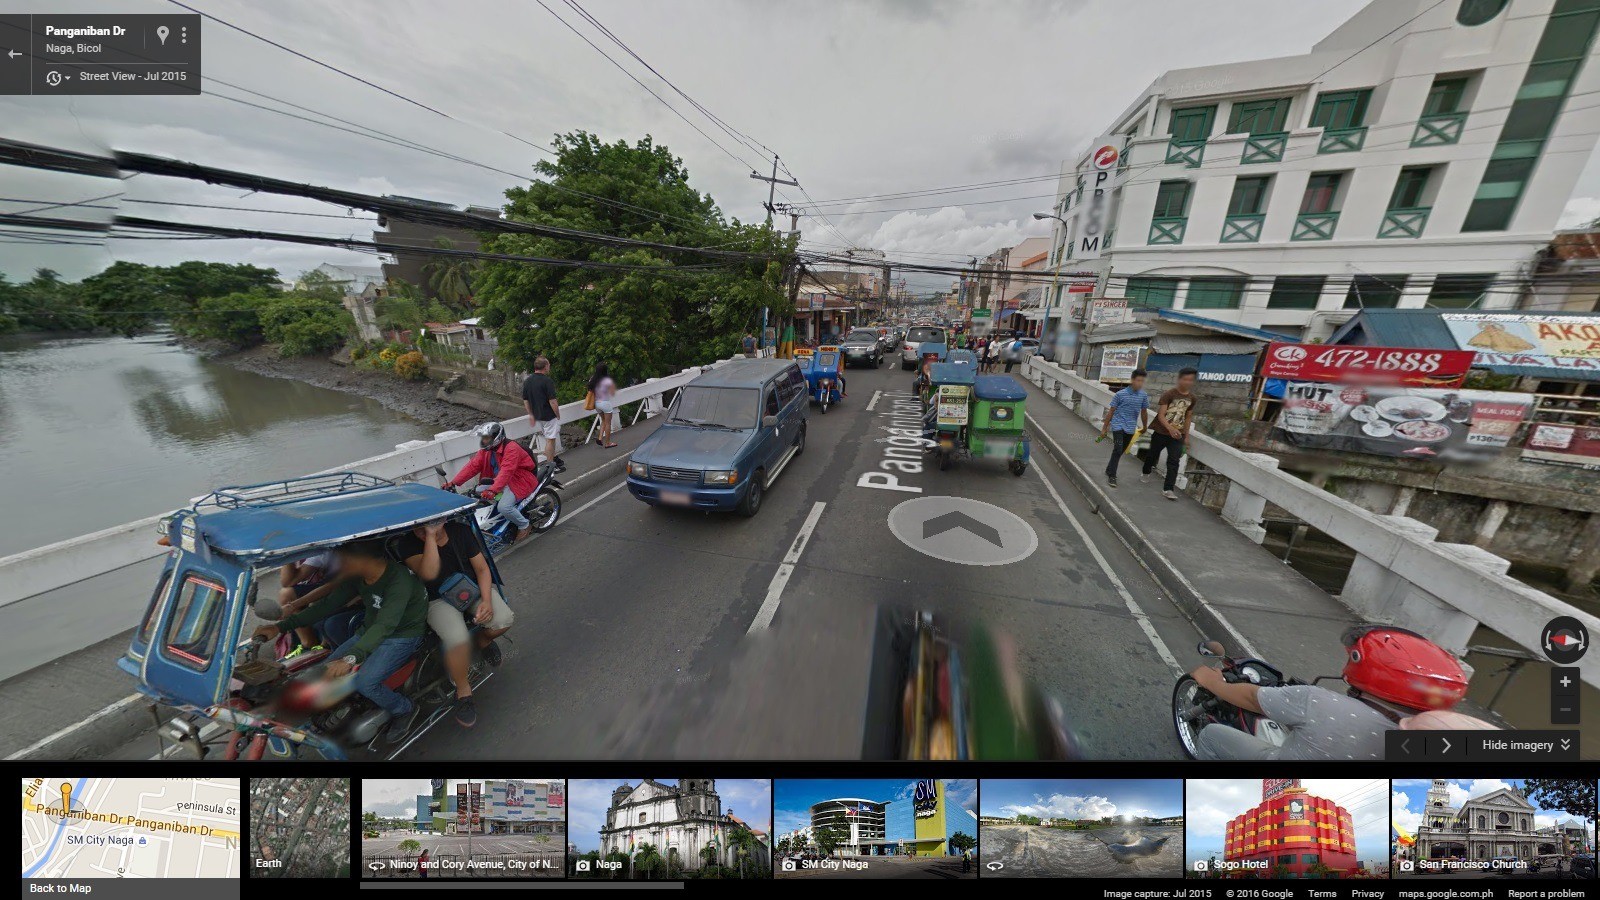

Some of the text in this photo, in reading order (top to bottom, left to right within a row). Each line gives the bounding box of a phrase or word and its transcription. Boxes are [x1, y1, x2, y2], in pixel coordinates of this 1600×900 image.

[1103, 300, 1127, 309] SINGER
[1314, 347, 1443, 373] 472-1888
[1551, 357, 1600, 369] LA
[1198, 371, 1252, 383] TANOD OUTPO
[1289, 386, 1333, 402] HUT
[1475, 407, 1522, 417] MEAL FOR 2
[916, 779, 936, 800] SM
